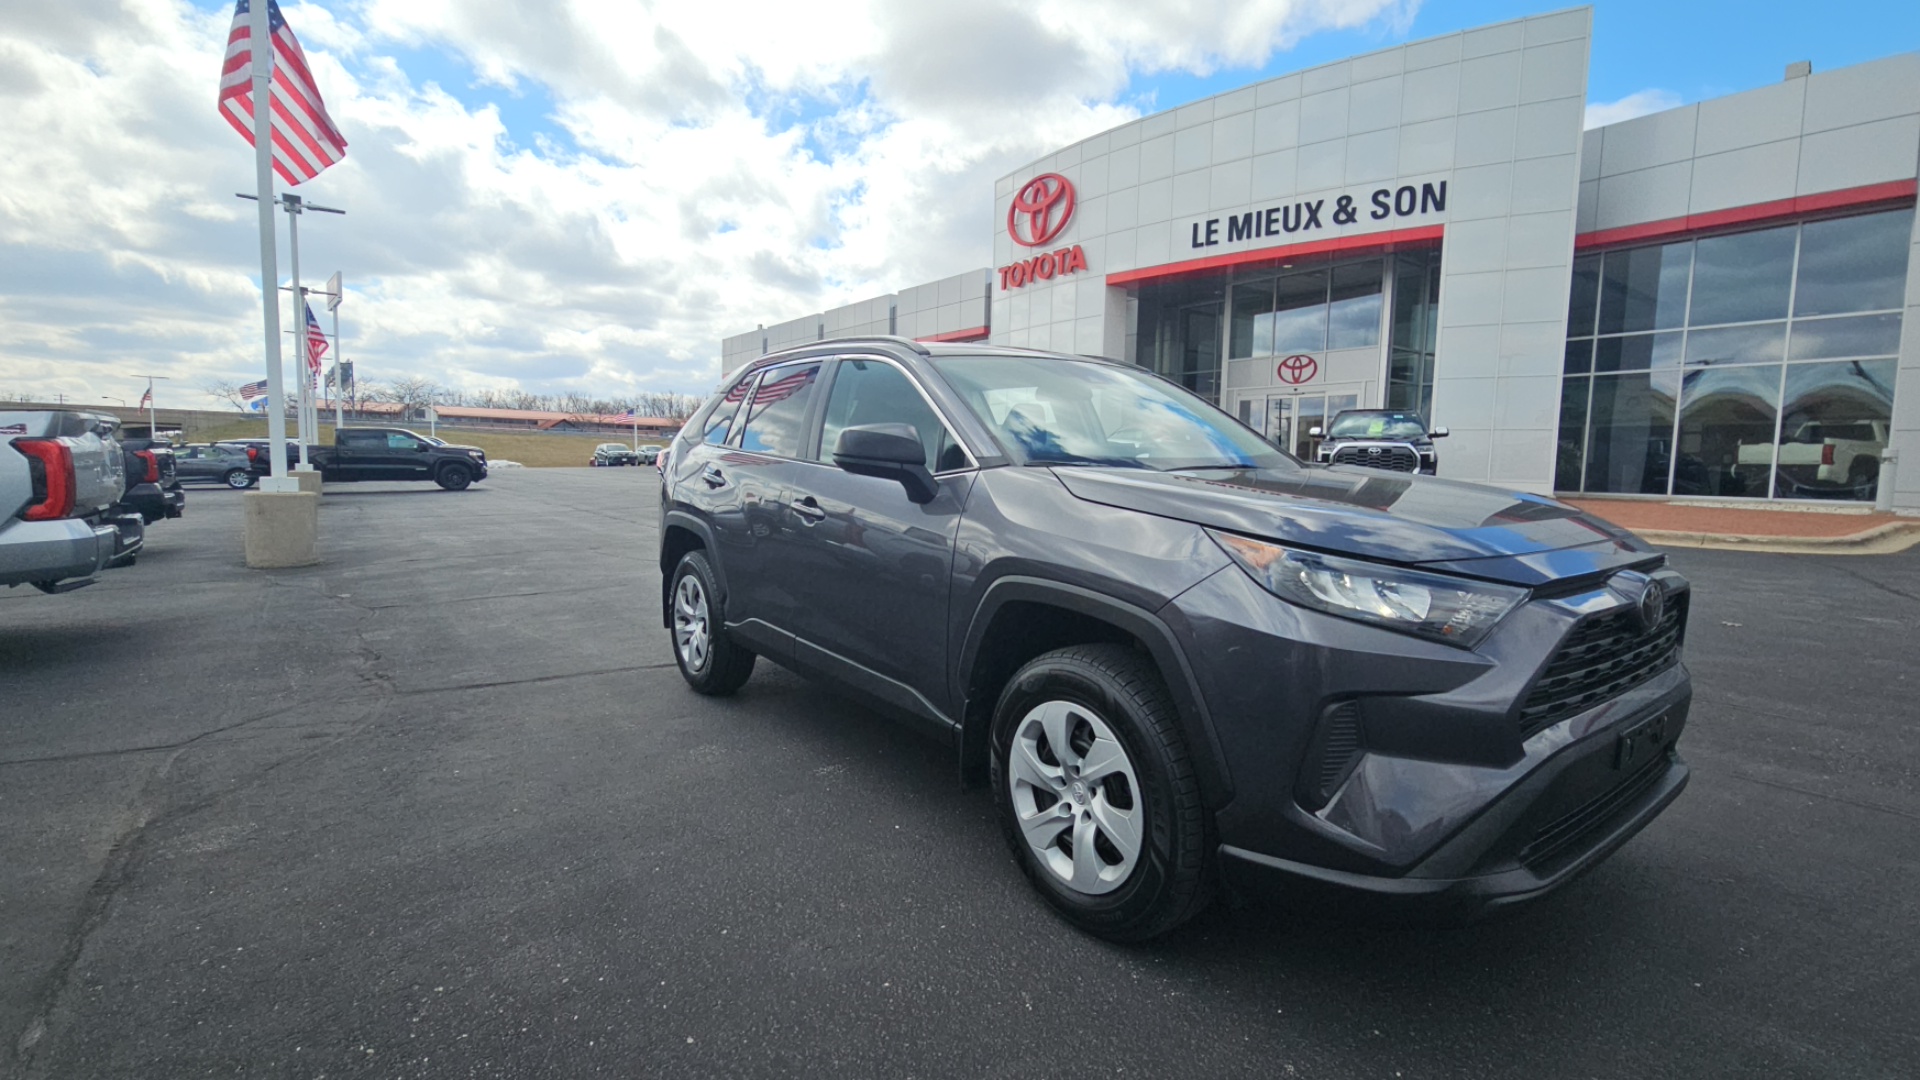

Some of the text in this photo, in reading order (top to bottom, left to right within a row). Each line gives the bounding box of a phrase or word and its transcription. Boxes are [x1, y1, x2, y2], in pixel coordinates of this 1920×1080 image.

[1191, 180, 1447, 249] LE MIEUX & SON
[998, 245, 1087, 291] TOYOTA
